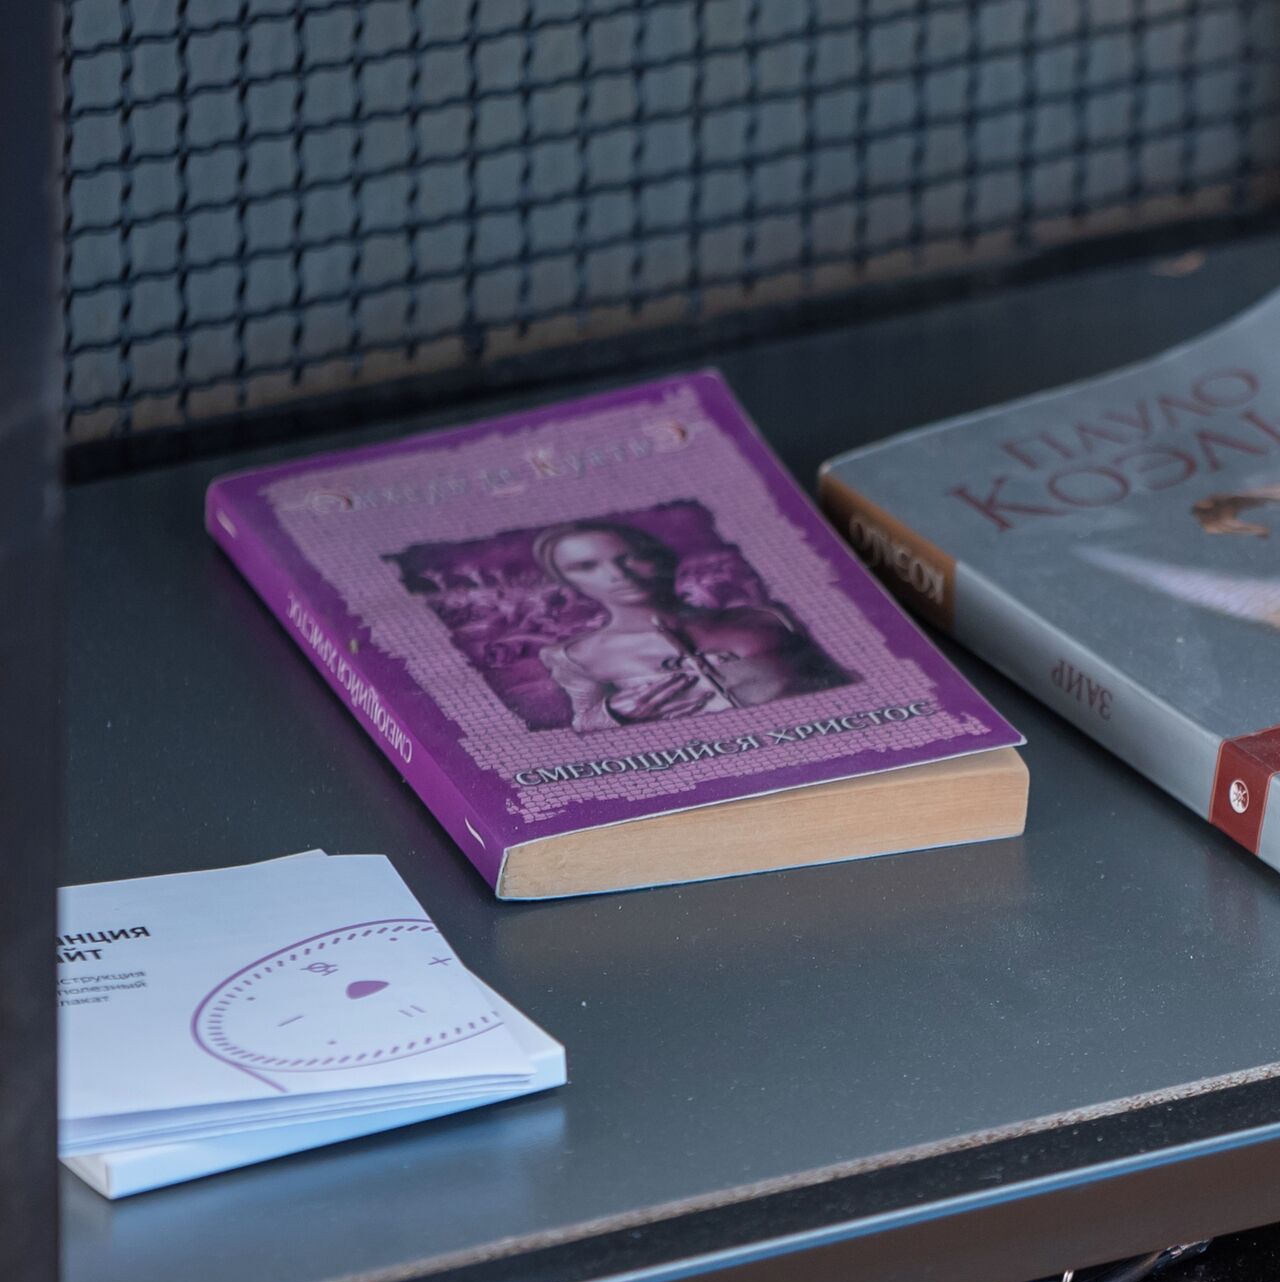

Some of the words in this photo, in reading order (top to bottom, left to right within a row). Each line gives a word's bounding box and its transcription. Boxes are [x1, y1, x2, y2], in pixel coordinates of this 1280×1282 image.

[1003, 367, 1259, 472] ПАУЛО
[338, 656, 413, 765] СМЕЮЩИЙСЯ
[1052, 659, 1114, 721] ЗАИР
[514, 734, 761, 789] СМЕЮЩИЙСЯ
[767, 700, 936, 744] ХРИСТОС
